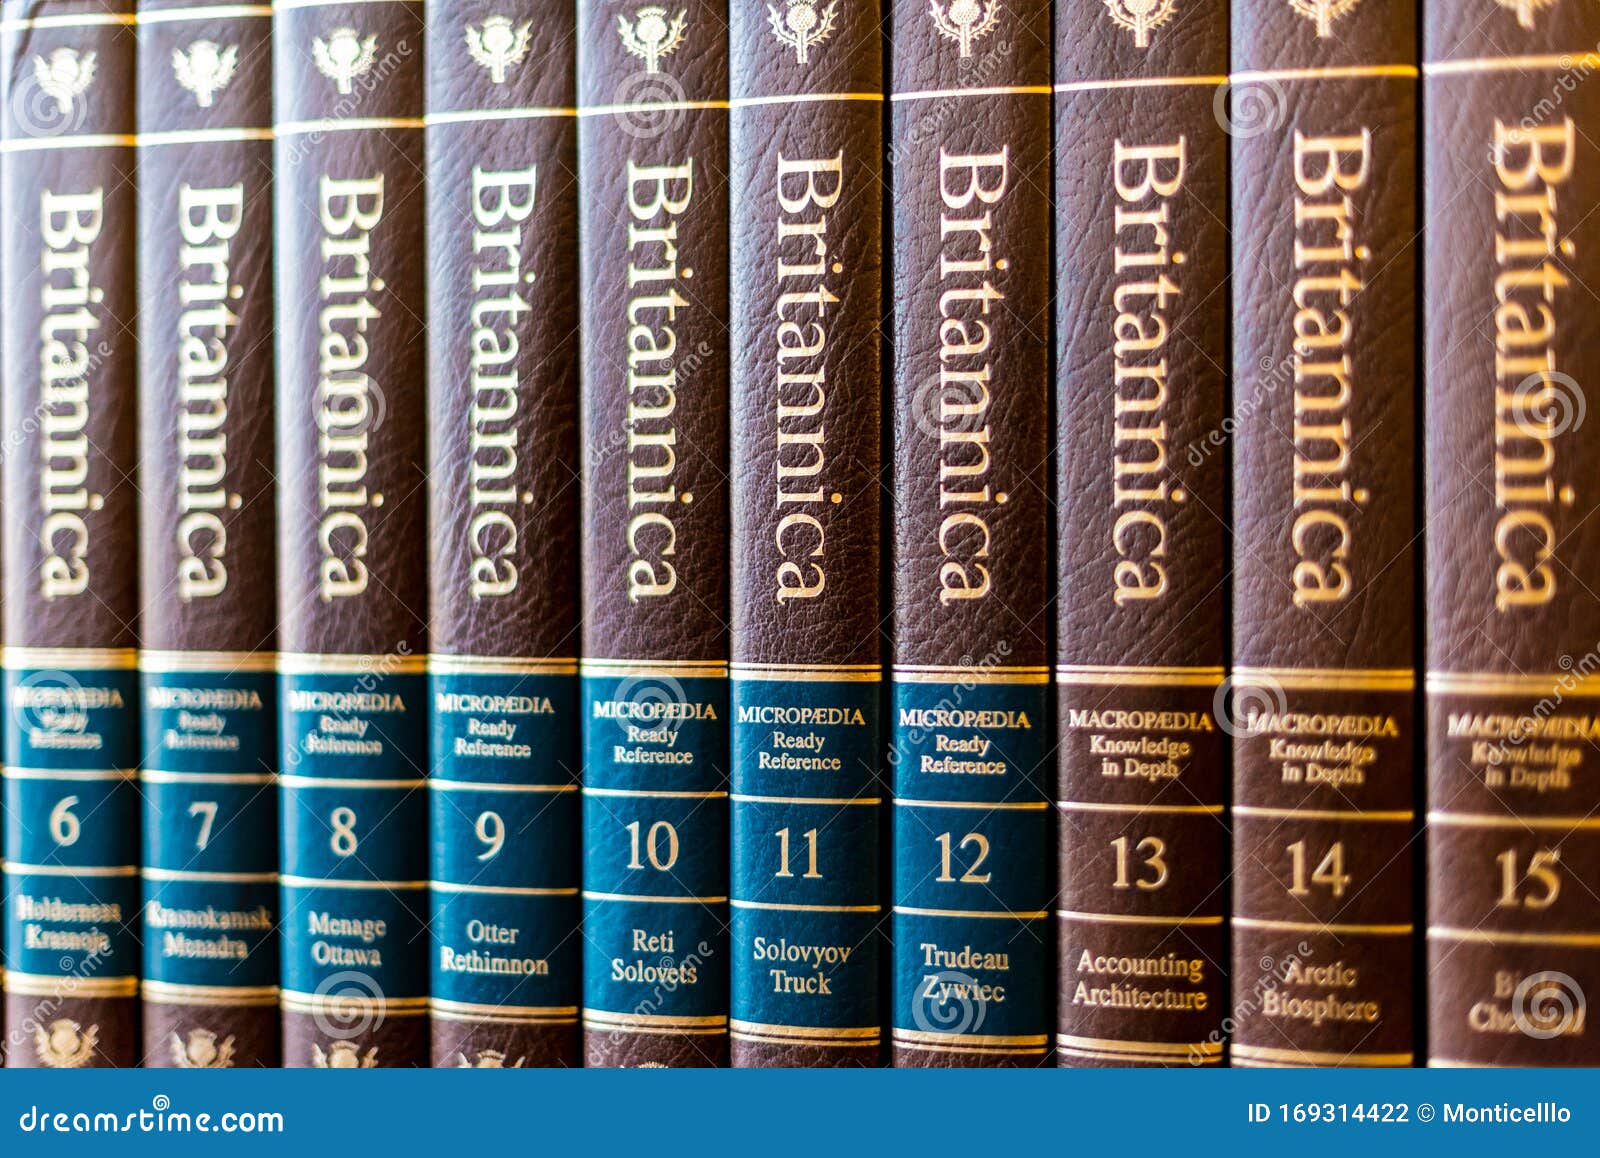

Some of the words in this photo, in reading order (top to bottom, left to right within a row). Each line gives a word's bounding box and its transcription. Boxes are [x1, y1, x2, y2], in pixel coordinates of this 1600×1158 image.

[775, 148, 843, 606] Britannica
[938, 144, 1008, 606] Britannica
[1113, 134, 1187, 607] Britannica
[1292, 127, 1371, 607] Britannica
[1495, 116, 1576, 612] Britannica
[40, 187, 104, 602] Britannica
[178, 182, 243, 603] Britannica
[319, 172, 385, 602] Britannica
[470, 163, 537, 600] Britannica
[626, 157, 694, 603] Britannica
[320, 715, 369, 738] Ready
[468, 718, 517, 741] Ready
[627, 726, 679, 746] Ready
[773, 731, 826, 753] Ready
[306, 733, 383, 755] Reference
[454, 738, 532, 759] Reference
[613, 744, 694, 765] Reference
[935, 734, 991, 758] Ready
[1089, 734, 1191, 760] Knowledge
[1269, 738, 1377, 764] Knowledge
[758, 751, 841, 771] Reference
[920, 756, 1007, 776] Reference
[1102, 759, 1121, 777] in
[1123, 757, 1179, 782] Depth
[1281, 762, 1302, 784] in
[1305, 763, 1366, 788] Depth
[50, 795, 80, 846] 6
[189, 801, 218, 850] 7
[330, 807, 358, 857] 8
[474, 811, 506, 862] 9
[626, 820, 680, 872] 10
[774, 827, 824, 880] 11
[934, 831, 993, 884] 12
[1109, 835, 1169, 891] 13
[1285, 840, 1352, 897] 14
[1495, 846, 1562, 910] 15
[308, 911, 386, 943] Menage
[466, 919, 519, 944] Otter
[632, 929, 675, 953] Reti
[311, 942, 383, 967] Ottawa
[440, 946, 549, 976] Rethimnon
[753, 937, 852, 968] Solovyov
[920, 942, 1010, 971] Trudeau
[1076, 949, 1204, 982] Accounting
[611, 958, 698, 985] Solovets
[770, 970, 832, 995] Truck
[1285, 961, 1358, 988] Arctic
[922, 974, 1006, 1006] Zywiec
[1072, 980, 1208, 1010] Architecture
[1262, 989, 1379, 1025] Biosphere
